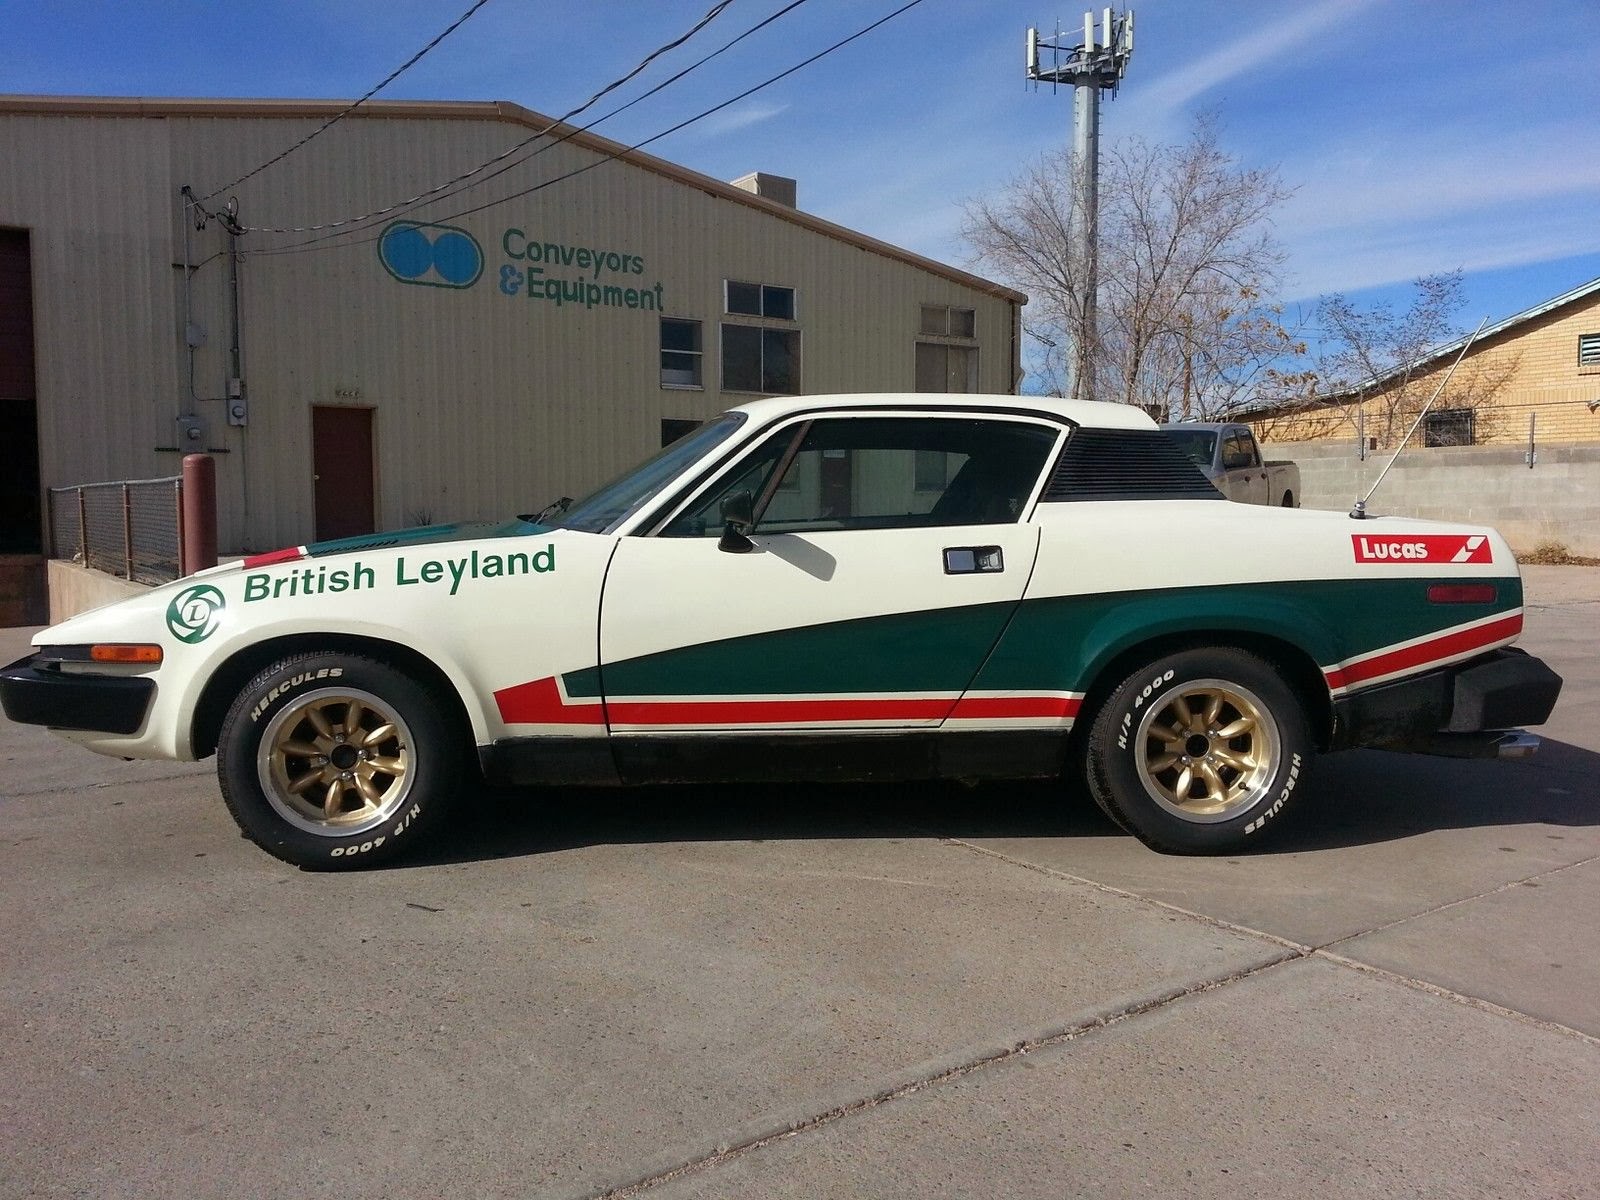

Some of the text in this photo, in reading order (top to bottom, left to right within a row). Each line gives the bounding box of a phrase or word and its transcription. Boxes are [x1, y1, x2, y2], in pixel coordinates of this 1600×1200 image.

[503, 228, 644, 279] Conveyors
[500, 264, 664, 311] & Equipment
[244, 543, 555, 602] British Leyland
[1360, 538, 1428, 559] Lucas
[188, 604, 205, 622] L
[250, 667, 343, 722] HERCULES
[1117, 669, 1175, 750] H/P 4000
[1245, 752, 1302, 835] HERCULES
[330, 803, 421, 857] H/P 4000
